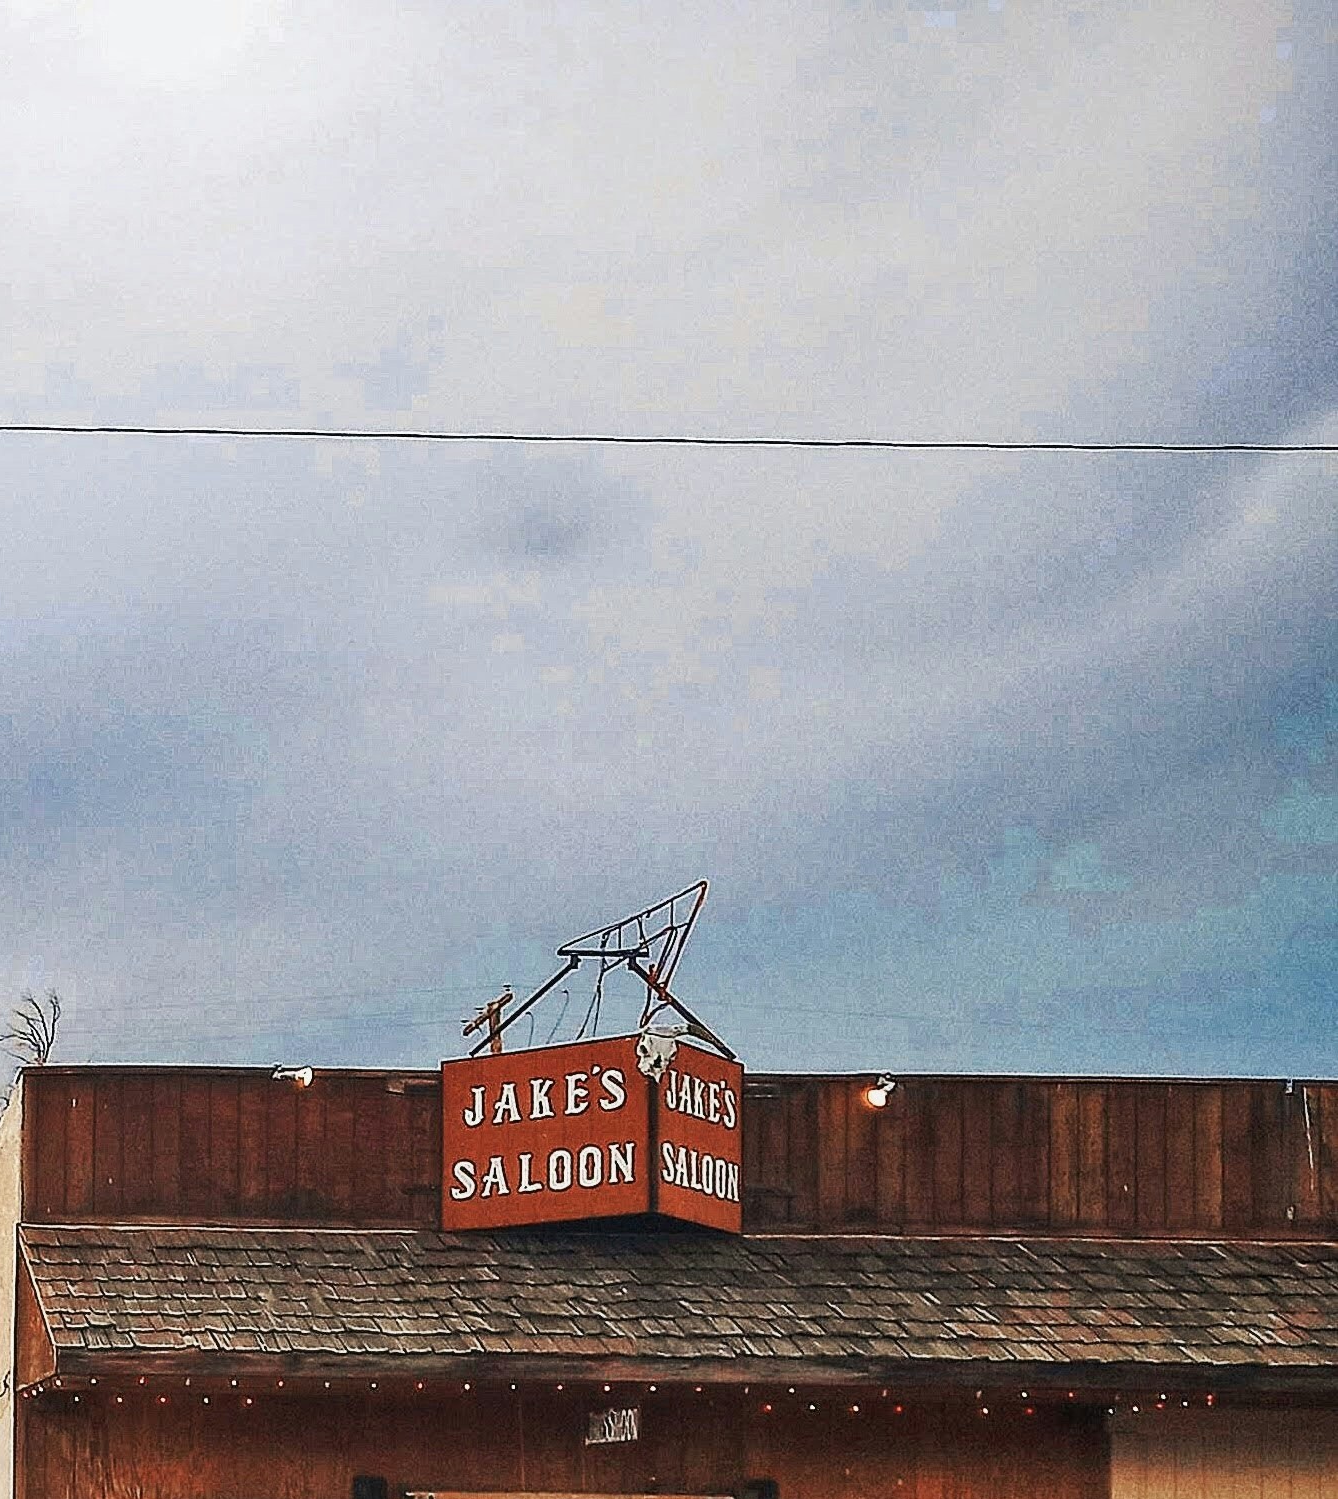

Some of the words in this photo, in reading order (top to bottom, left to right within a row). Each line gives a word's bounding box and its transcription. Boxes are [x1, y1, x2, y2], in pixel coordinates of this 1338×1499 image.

[463, 1066, 626, 1127] JAKE'S
[666, 1071, 737, 1129] JAKE'S
[450, 1142, 636, 1200] SALOON
[661, 1141, 740, 1202] SALOON
